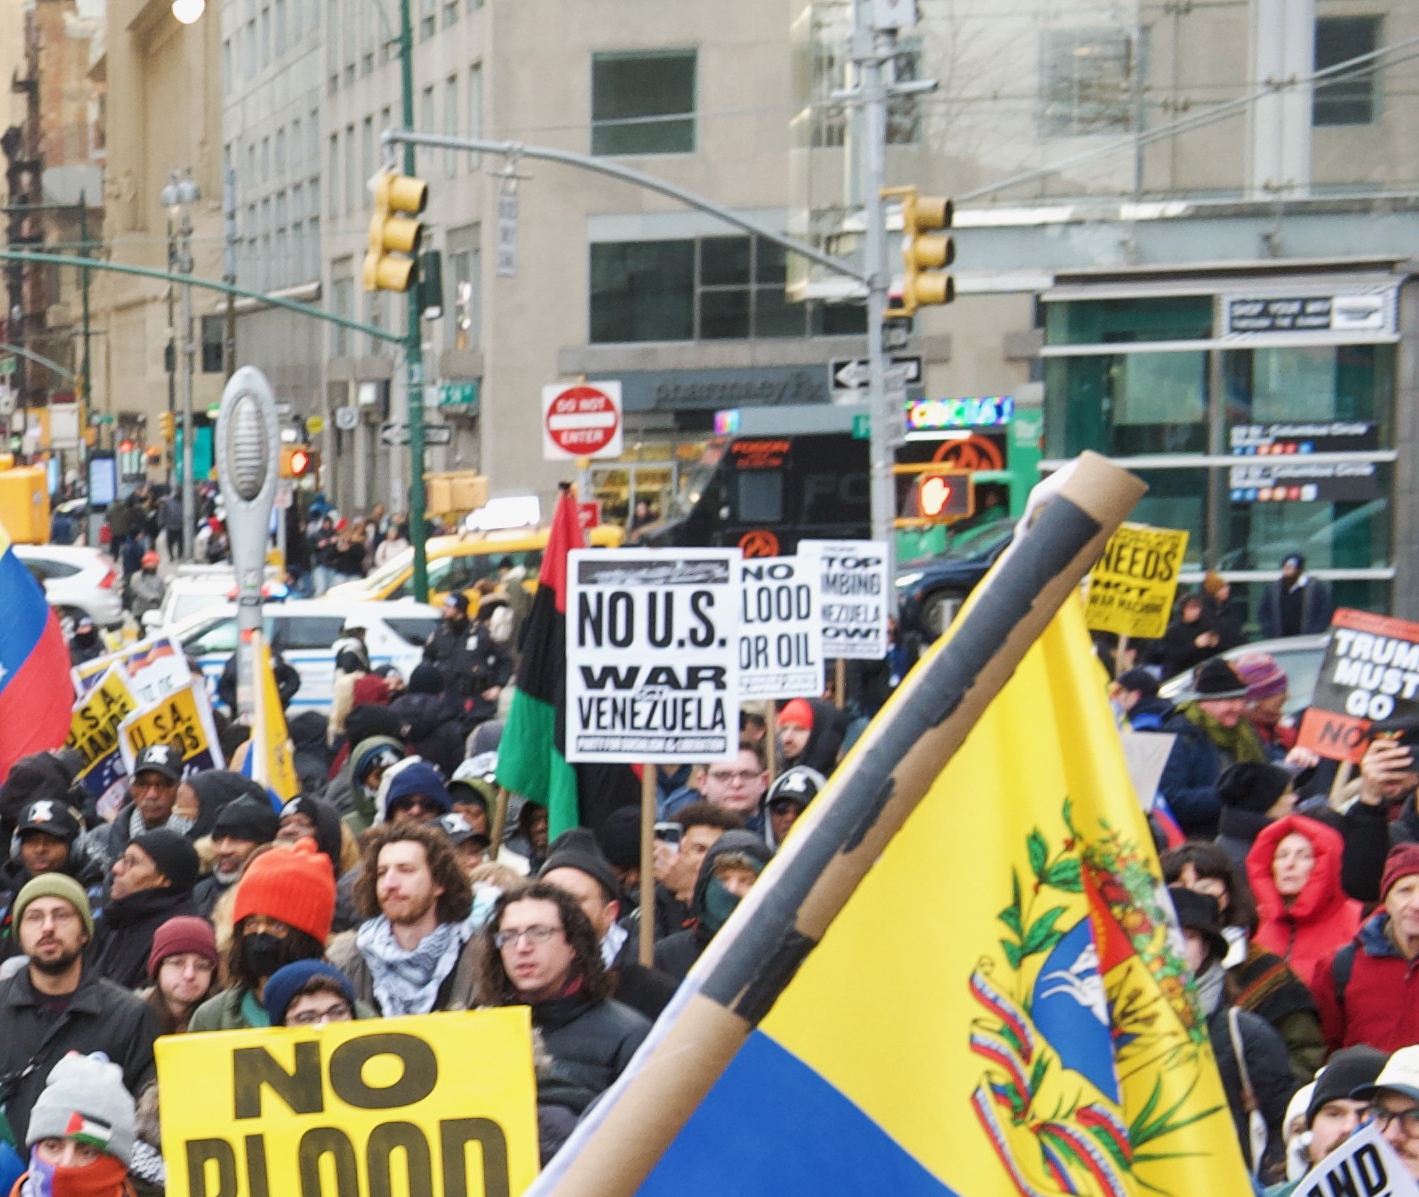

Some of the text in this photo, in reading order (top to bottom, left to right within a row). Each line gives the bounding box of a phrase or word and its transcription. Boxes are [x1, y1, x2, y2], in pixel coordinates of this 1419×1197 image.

[557, 396, 606, 412] DO NOT
[561, 429, 604, 445] ENTER
[741, 563, 794, 582] NO
[820, 556, 881, 570] TOP
[1097, 549, 1178, 583] NEEDS
[822, 573, 881, 595] MBING
[1092, 579, 1149, 597] NOT
[741, 584, 811, 624] LOOD
[822, 603, 880, 624] EZUELA
[577, 590, 728, 648] NO U.S.
[822, 626, 879, 640] OW!
[739, 632, 816, 671] OR OIL
[1334, 629, 1419, 671] TRUM
[579, 665, 728, 691] WAR
[1333, 658, 1419, 699] MUST
[576, 696, 728, 733] VENEZUELA
[1345, 689, 1395, 721] GO
[232, 1031, 439, 1120] NO
